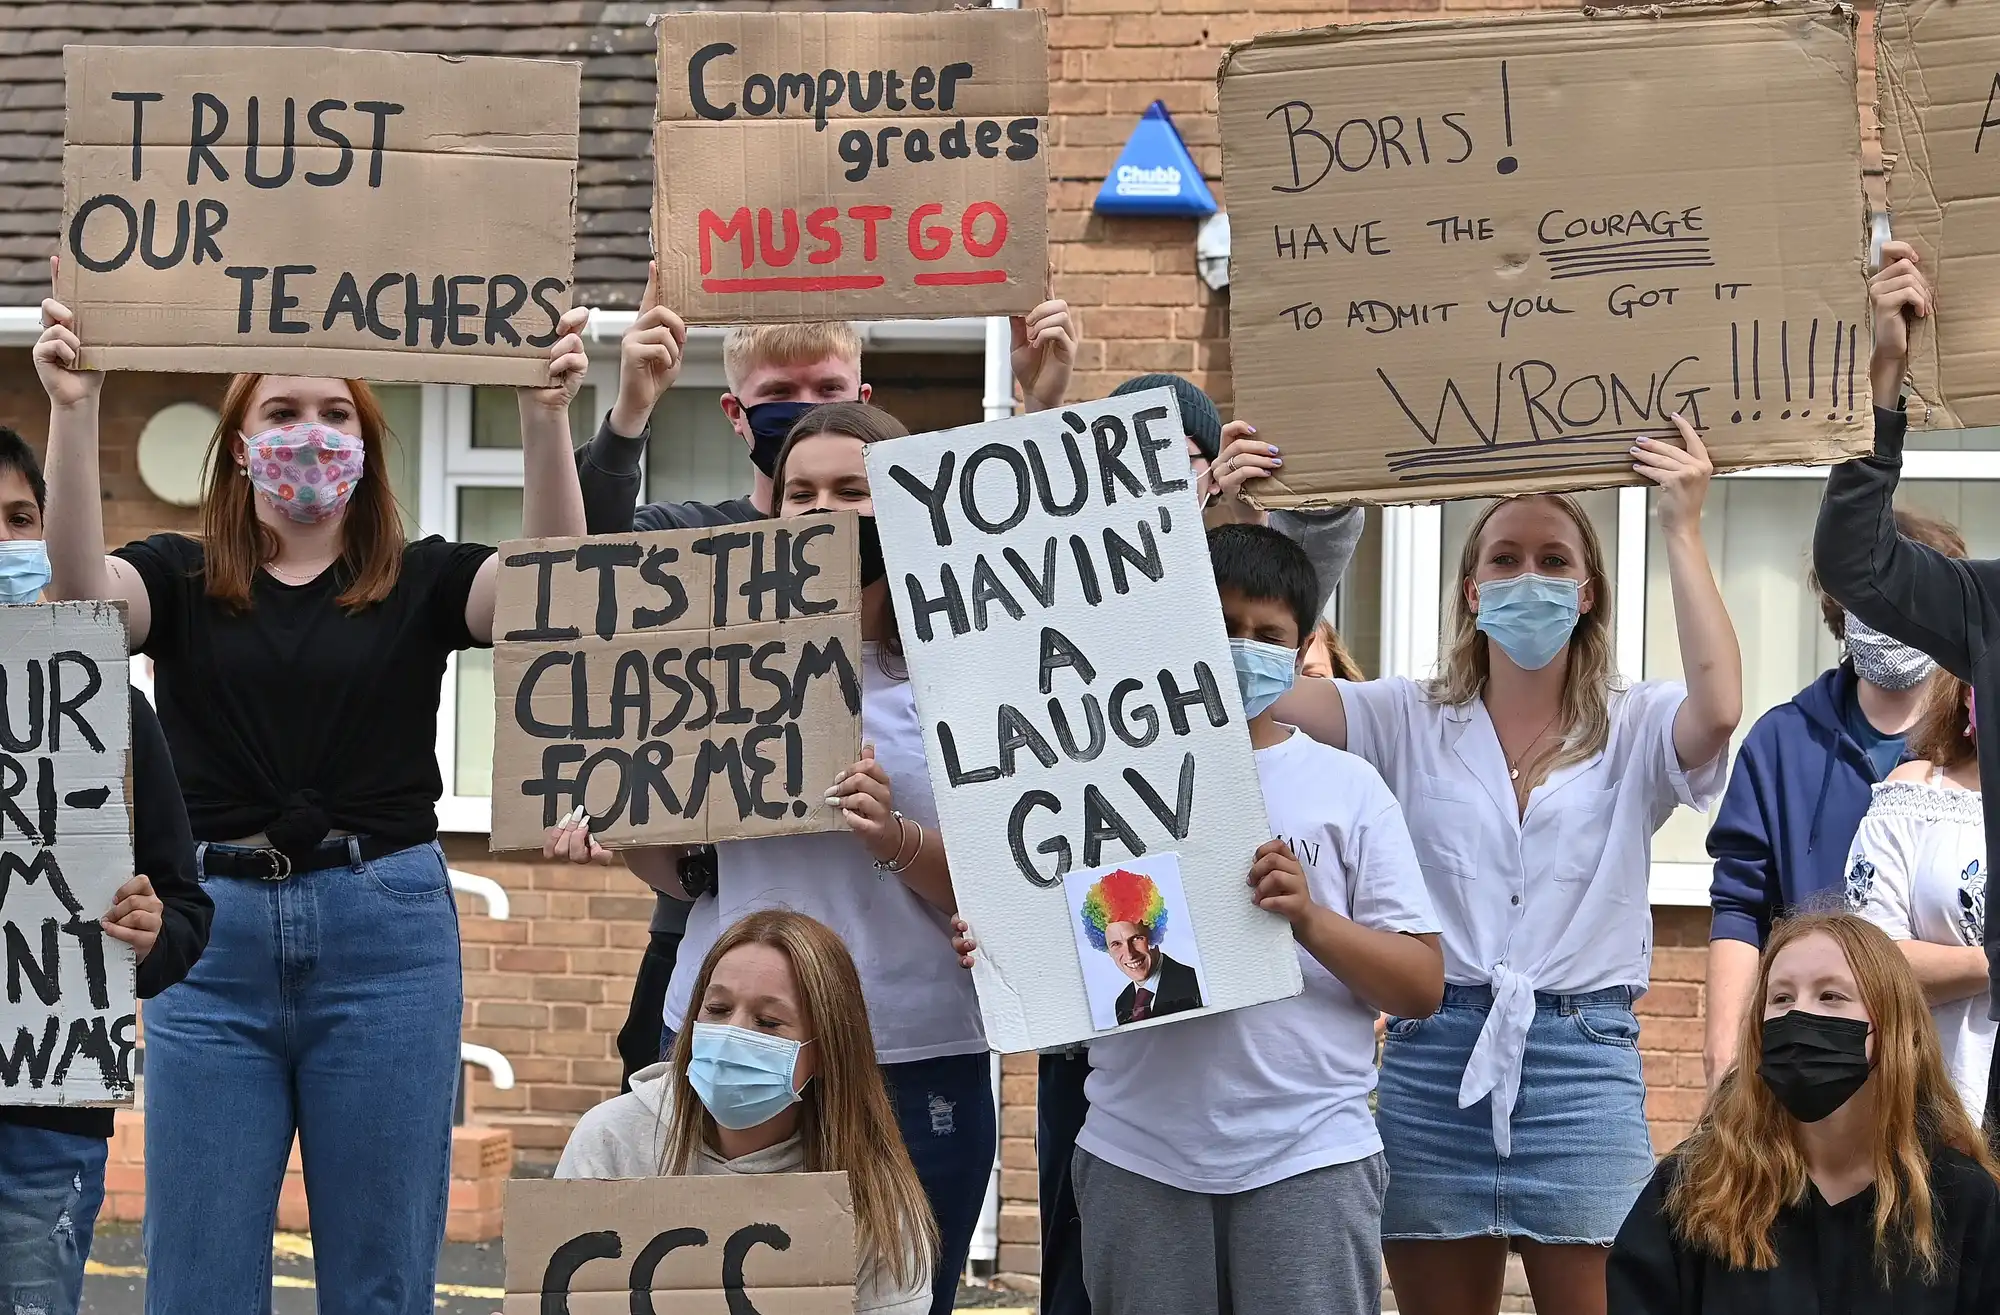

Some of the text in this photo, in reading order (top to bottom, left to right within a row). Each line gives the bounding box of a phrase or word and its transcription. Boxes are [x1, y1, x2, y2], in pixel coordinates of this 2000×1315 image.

[688, 42, 972, 131] Computer
[111, 91, 404, 189] TRUST
[838, 117, 1038, 182] grades
[1117, 165, 1181, 182] Chubb
[69, 193, 228, 272] OUR
[699, 201, 1008, 275] MUST GO
[1275, 206, 1703, 260] HAVE THE COURAGE
[225, 265, 566, 349] TEACHERS
[1280, 302, 1322, 331] TO
[1347, 302, 1458, 334] ADMIT
[1608, 283, 1680, 318] GOT
[1715, 282, 1752, 301] IT
[888, 405, 1189, 548] YOU'RE
[692, 524, 838, 628] THE
[905, 506, 1173, 643] HAVIN'
[515, 636, 861, 741] CLASSISM
[1039, 626, 1097, 694] A
[936, 661, 1229, 788] LAUGH
[522, 722, 809, 833] FOR ME!
[1007, 752, 1196, 889] GAV
[2, 913, 110, 1010] NT
